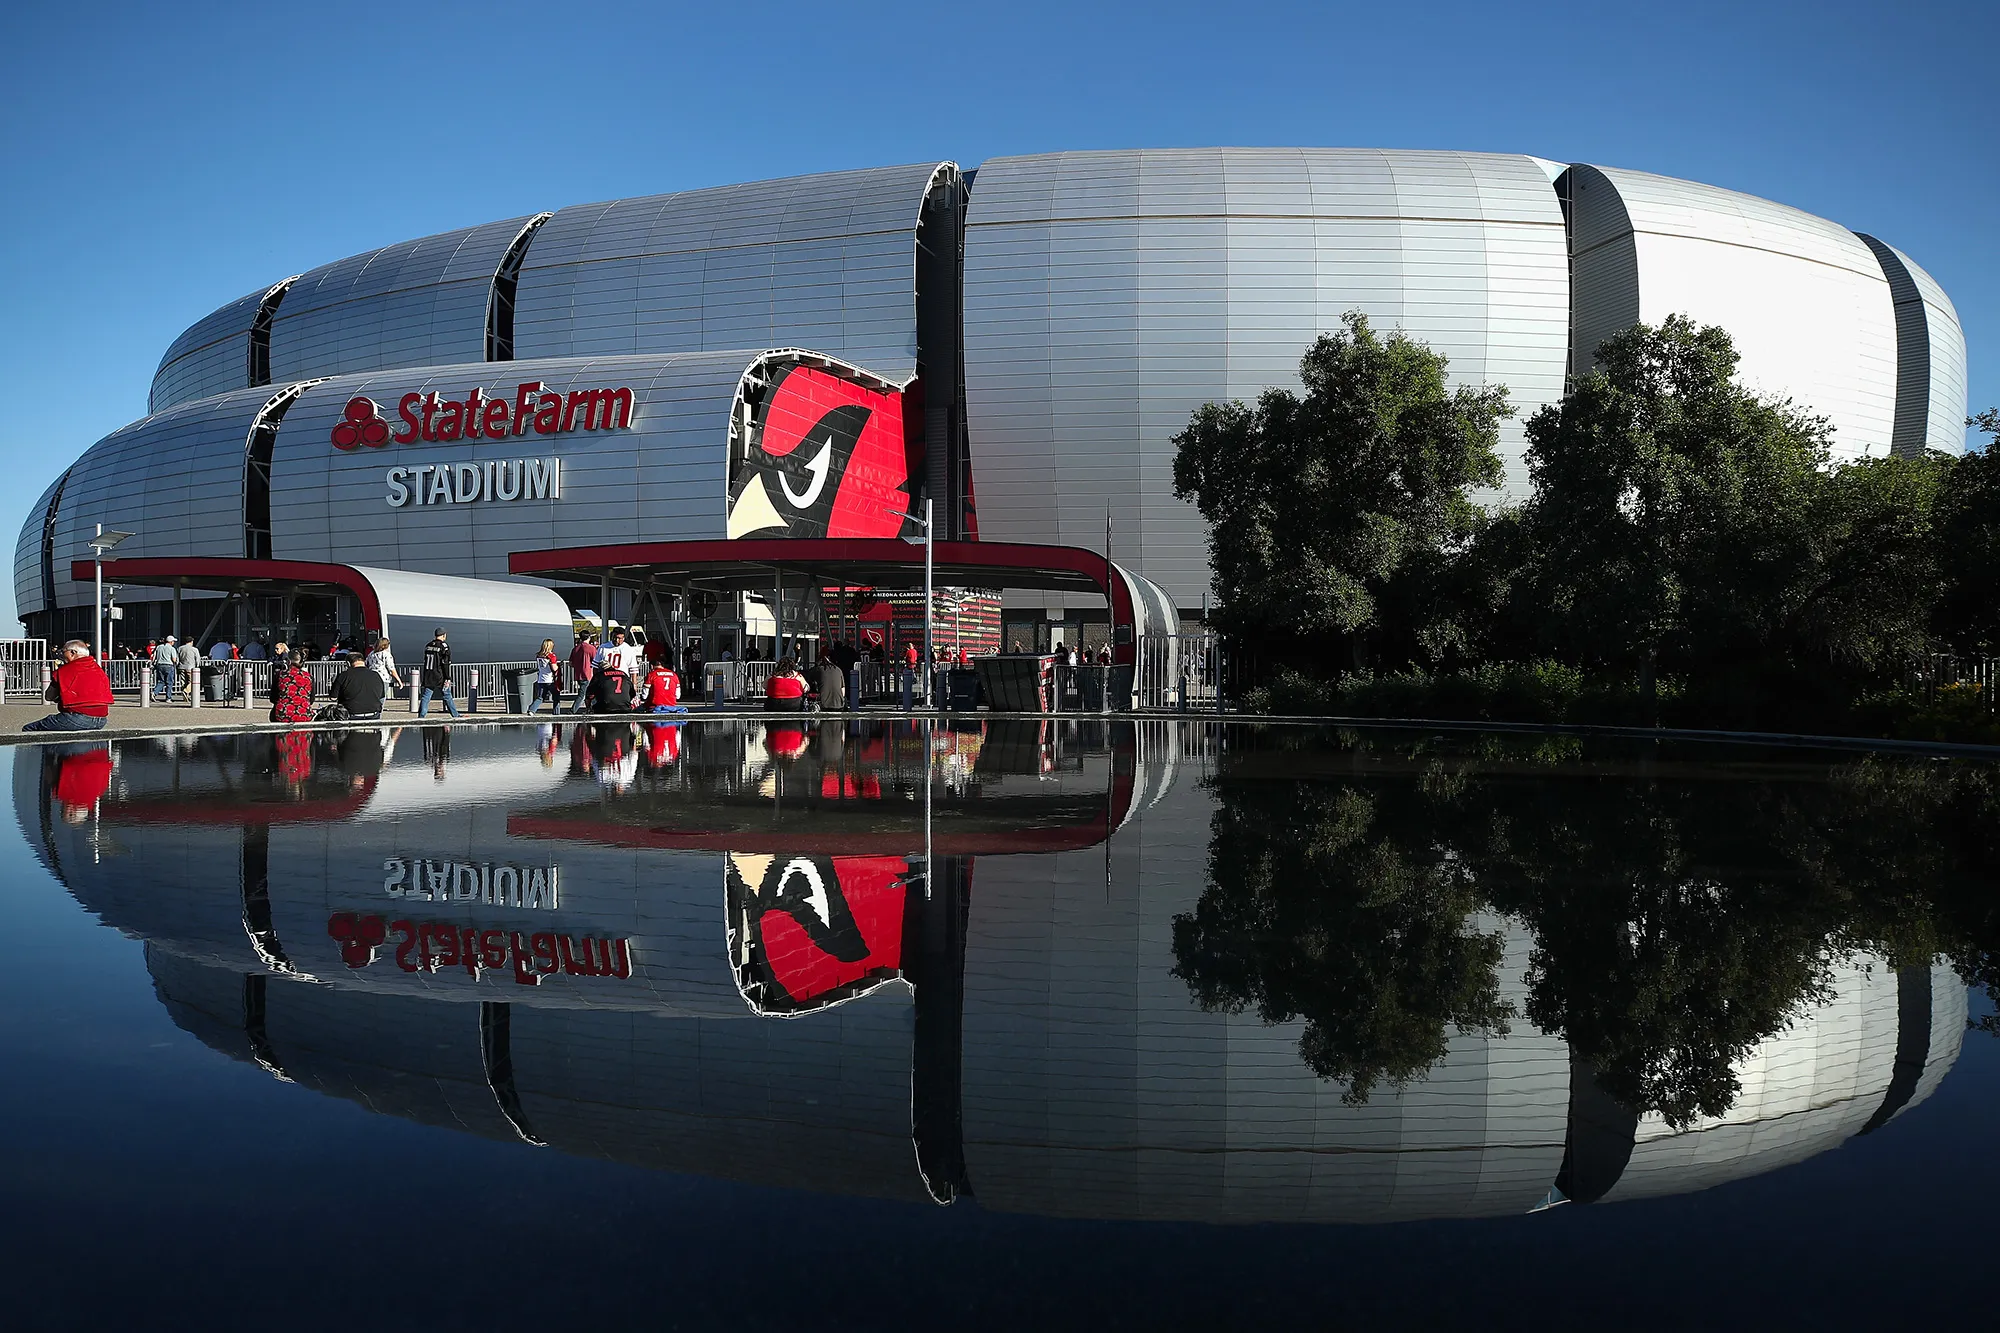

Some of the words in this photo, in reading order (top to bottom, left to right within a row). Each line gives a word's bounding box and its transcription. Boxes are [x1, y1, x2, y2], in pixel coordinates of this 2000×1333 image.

[385, 457, 561, 507] STADIUM
[426, 653, 434, 670] 11
[607, 652, 622, 669] 10
[612, 676, 623, 694] 7
[663, 677, 671, 690] 7
